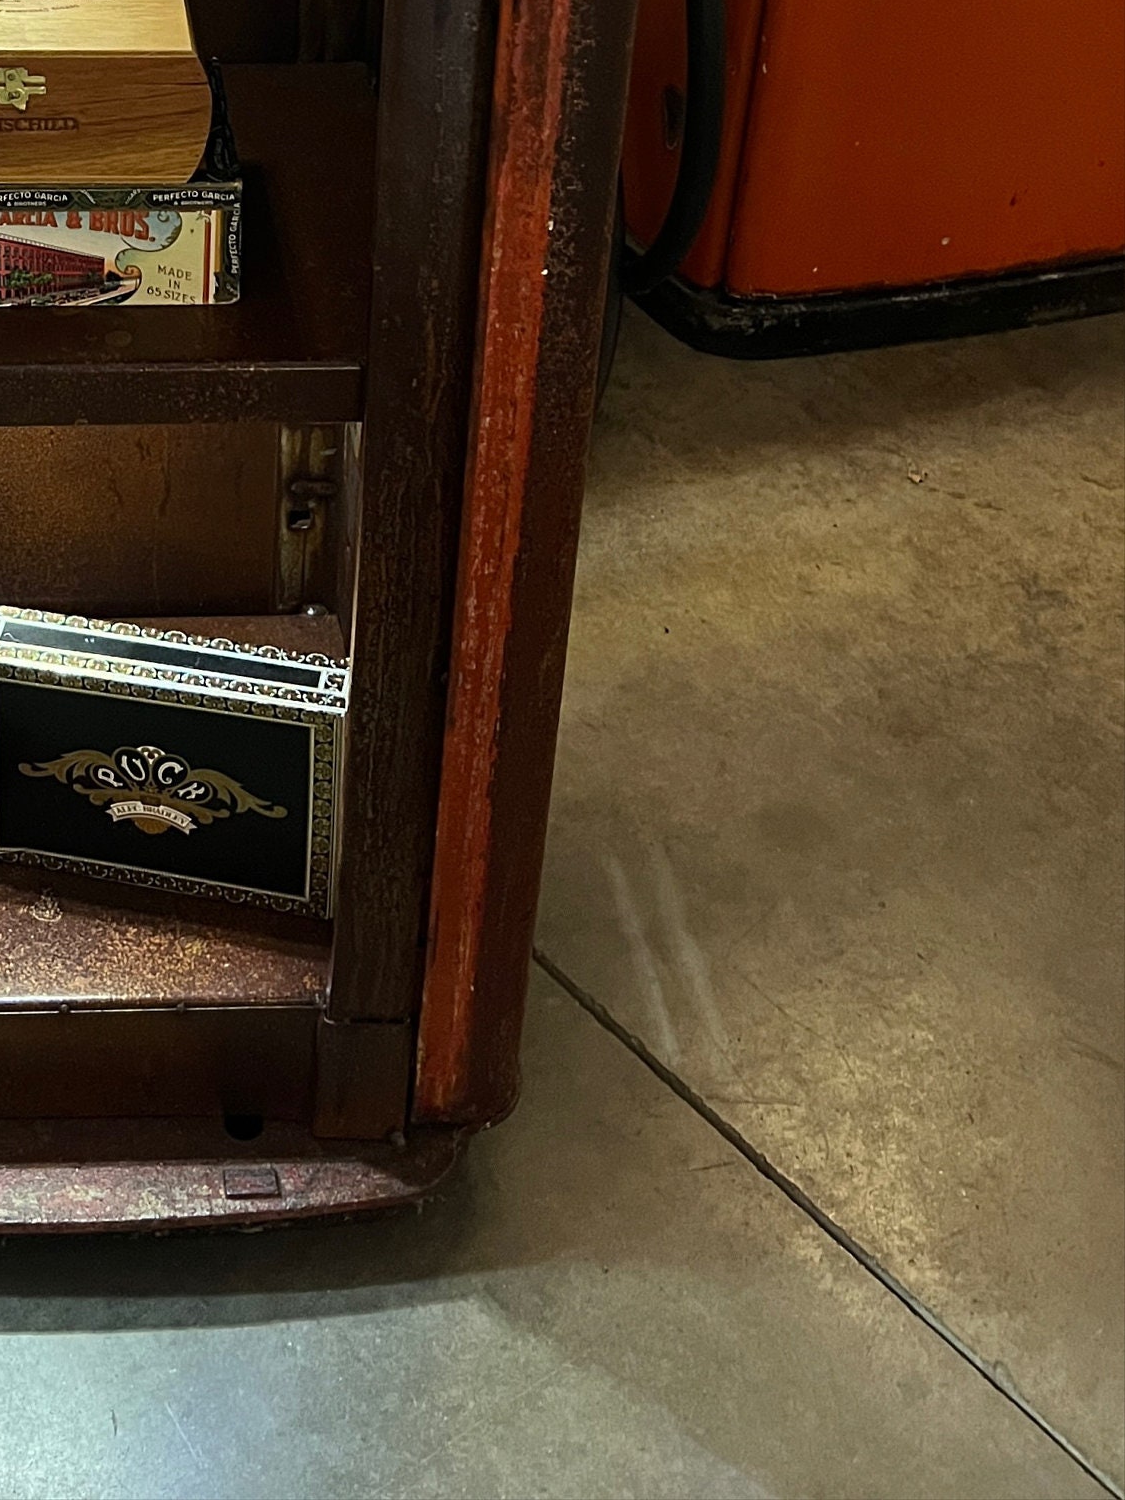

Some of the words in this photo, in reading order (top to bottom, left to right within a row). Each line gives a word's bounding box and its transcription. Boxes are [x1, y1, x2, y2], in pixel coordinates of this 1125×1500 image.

[35, 191, 68, 201] GARCIA
[152, 190, 199, 201] PERFECTO
[201, 191, 235, 201] GARCIA
[229, 202, 241, 232] GARCIA
[66, 211, 82, 229] &
[89, 211, 156, 242] BROS.
[157, 264, 192, 281] MADE
[168, 280, 181, 290] IN
[146, 286, 162, 297] 65
[164, 290, 196, 303] SIZES
[97, 754, 206, 800] PUCK
